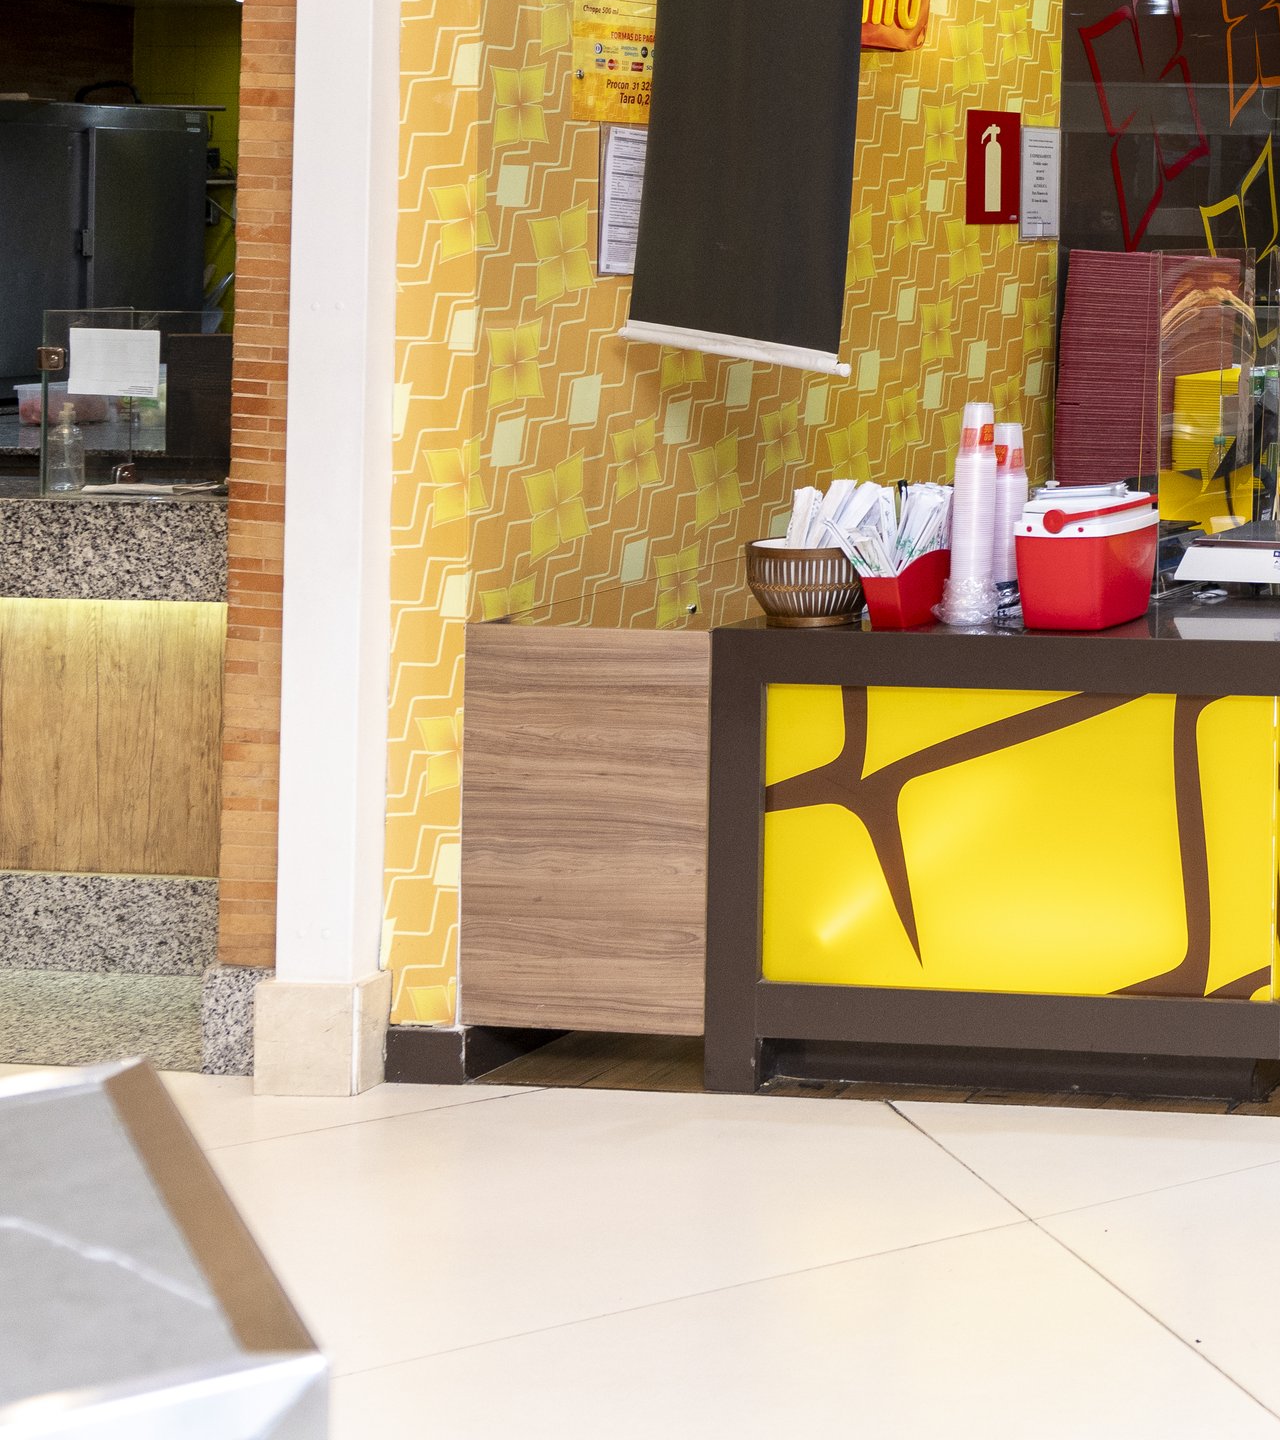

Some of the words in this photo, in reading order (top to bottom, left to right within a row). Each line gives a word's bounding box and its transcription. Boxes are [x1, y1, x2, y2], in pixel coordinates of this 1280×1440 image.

[611, 31, 634, 41] FORMAS
[635, 33, 642, 42] DE
[606, 79, 629, 91] Procon
[632, 82, 640, 91] 31
[619, 92, 636, 105] Tara
